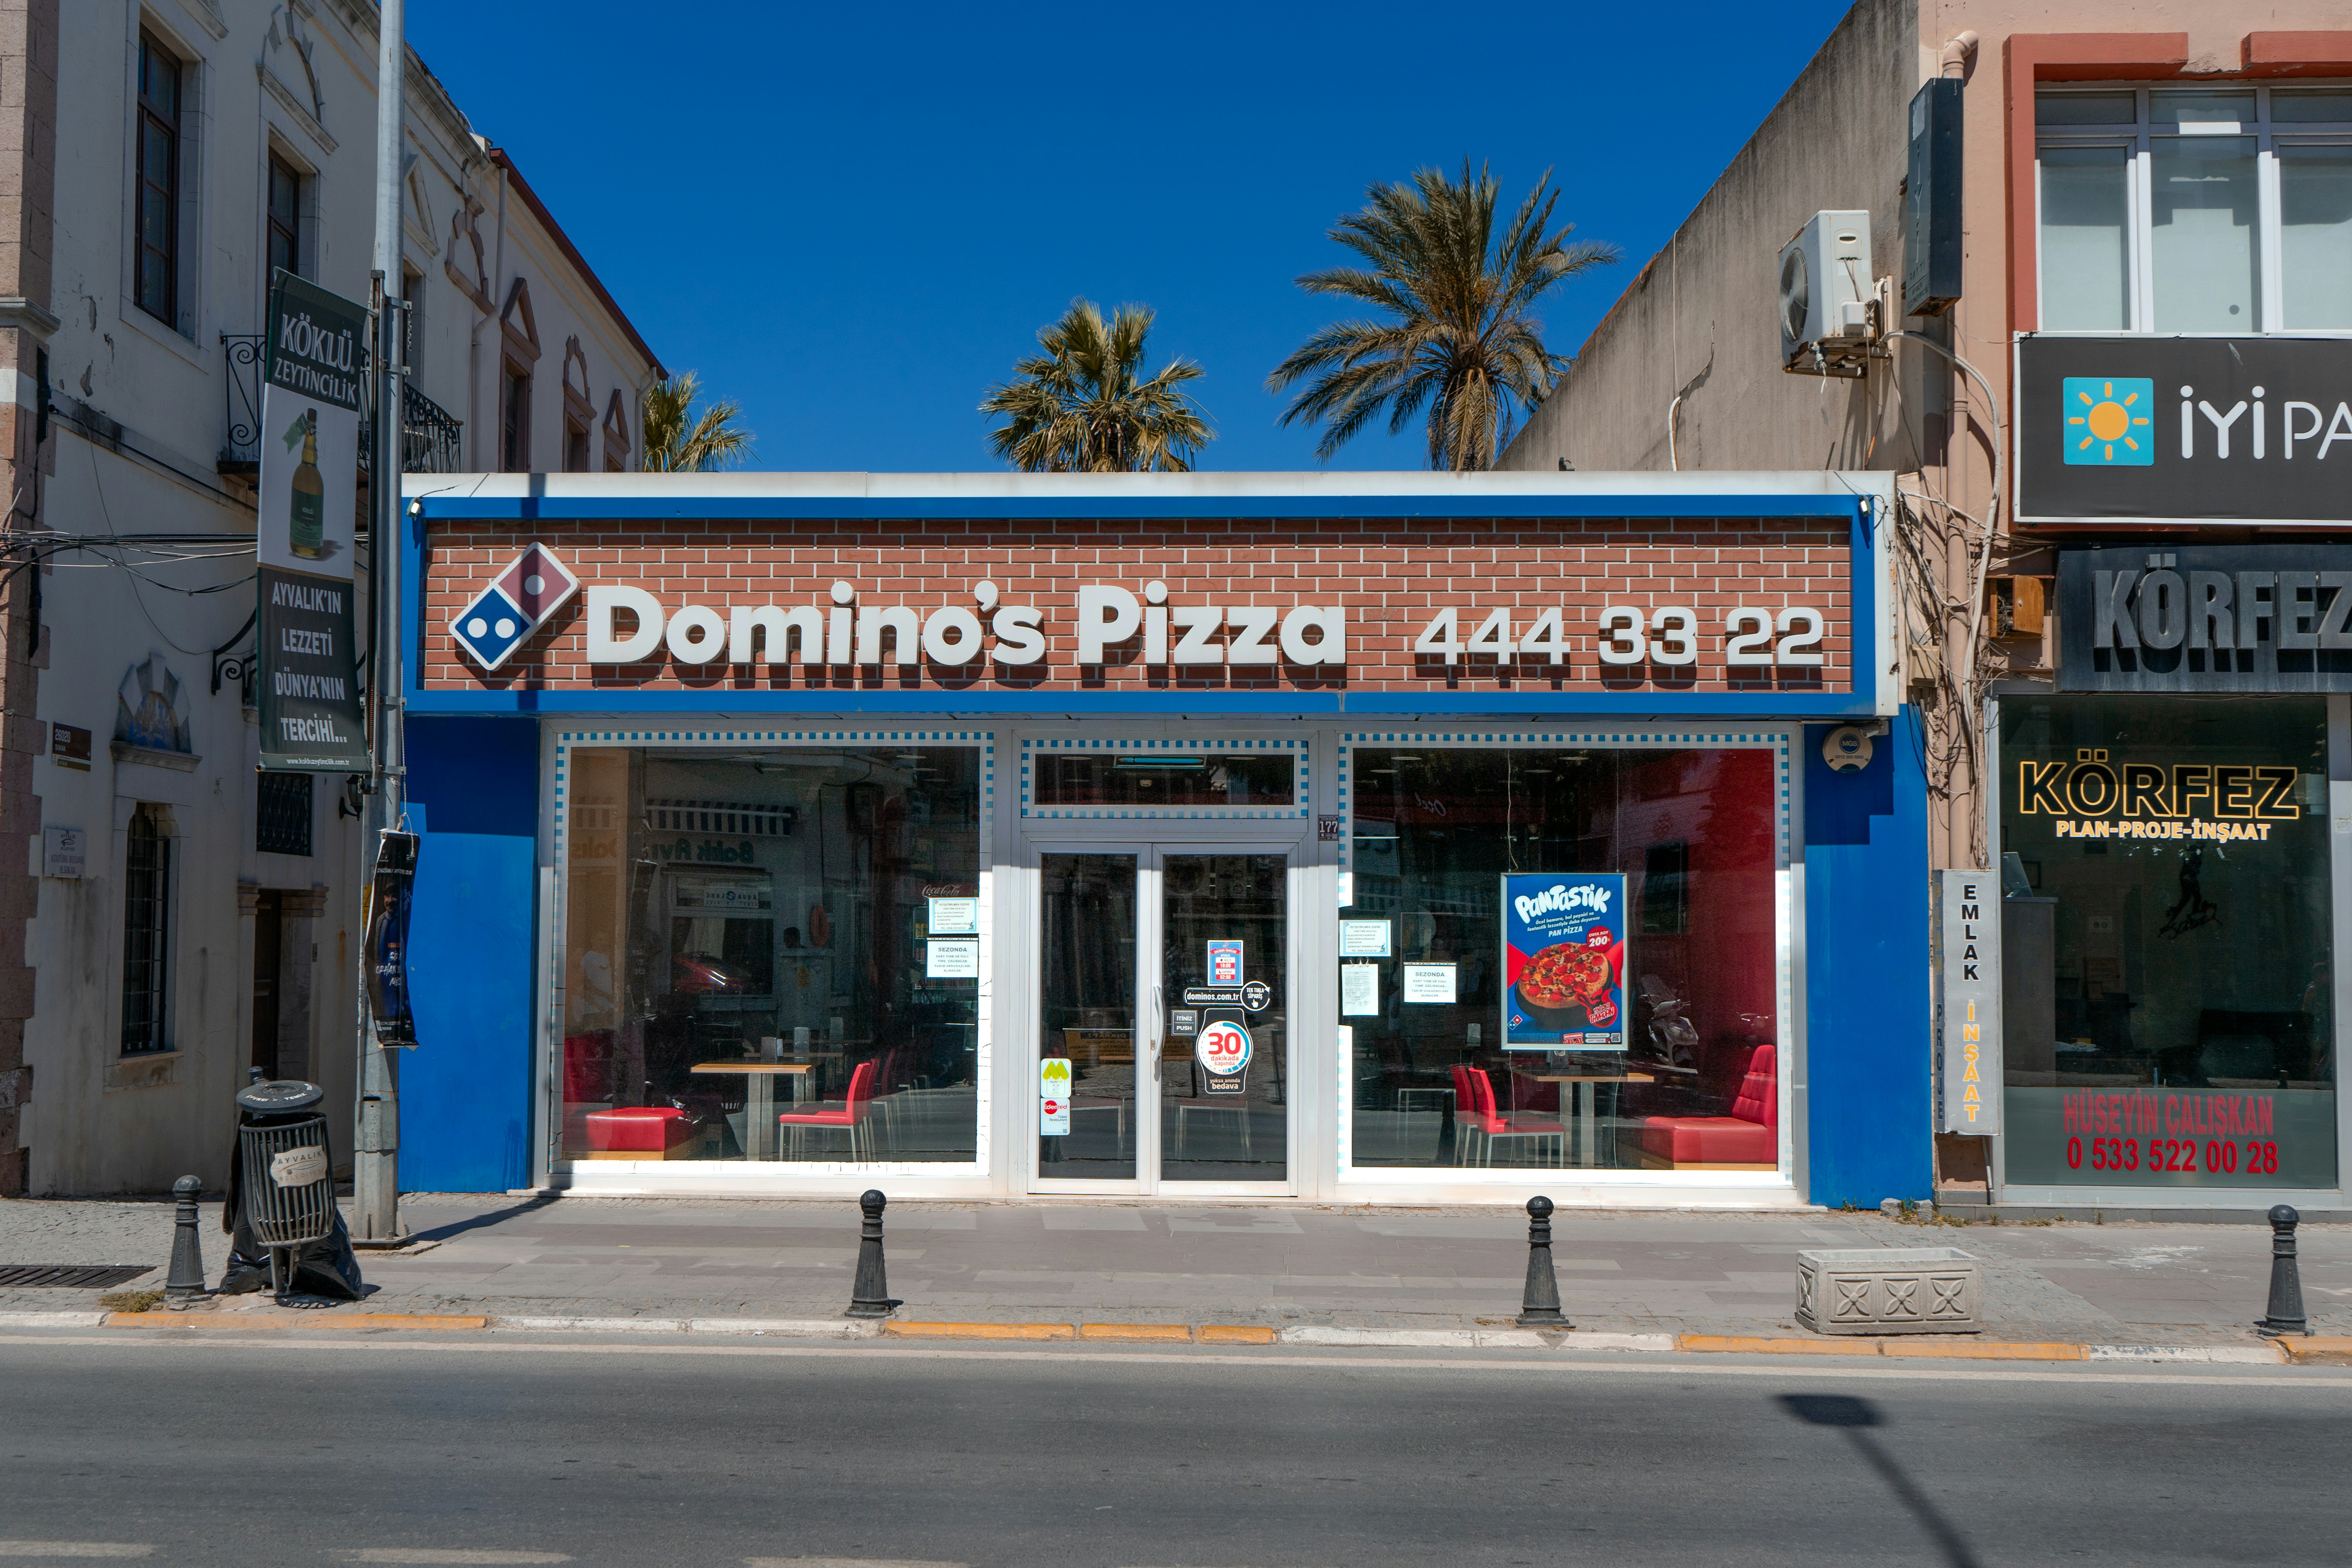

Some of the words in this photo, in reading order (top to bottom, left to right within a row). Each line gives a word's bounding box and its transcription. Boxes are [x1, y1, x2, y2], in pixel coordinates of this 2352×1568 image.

[280, 313, 353, 374] KÖKLÜ
[2180, 385, 2265, 459] İYİ
[2284, 401, 2352, 460] PA
[272, 581, 341, 614] AYVALIK'IN
[2093, 553, 2352, 650] KÖRFEZ
[586, 580, 1046, 666] Domino's
[1078, 580, 1346, 666] Pizza
[1414, 607, 1570, 665] 444
[1598, 606, 1698, 666] 33
[1725, 607, 1824, 665] 22
[282, 627, 333, 656] LEZZETİ
[275, 666, 345, 700] DÜNYA'NIN
[55, 728, 70, 743] 26020
[280, 713, 347, 743] TERCİHİ...
[2019, 748, 2300, 820] KÖRFEZ
[1320, 821, 1338, 833] 177
[2056, 818, 2271, 843] PLAN-PROJE-İNŞAAT
[51, 853, 68, 863] ATATÜRK
[1548, 929, 1562, 937] PAN
[1563, 925, 1583, 935] PİZZA
[1961, 884, 1981, 981] EMLAK
[1187, 992, 1240, 1001] dominos.com.tr
[1208, 1032, 1241, 1054] 30
[1963, 999, 1981, 1122] İNŞAAT
[2063, 1088, 2158, 1135] HÜSEYİN
[2165, 1094, 2274, 1141] ÇALIŞKAN
[278, 1150, 322, 1164] AYVALIK
[2068, 1136, 2083, 1169] 0
[2092, 1138, 2140, 1171] 533
[2149, 1139, 2197, 1172] 522
[2206, 1140, 2238, 1173] 00
[2247, 1141, 2279, 1174] 28
